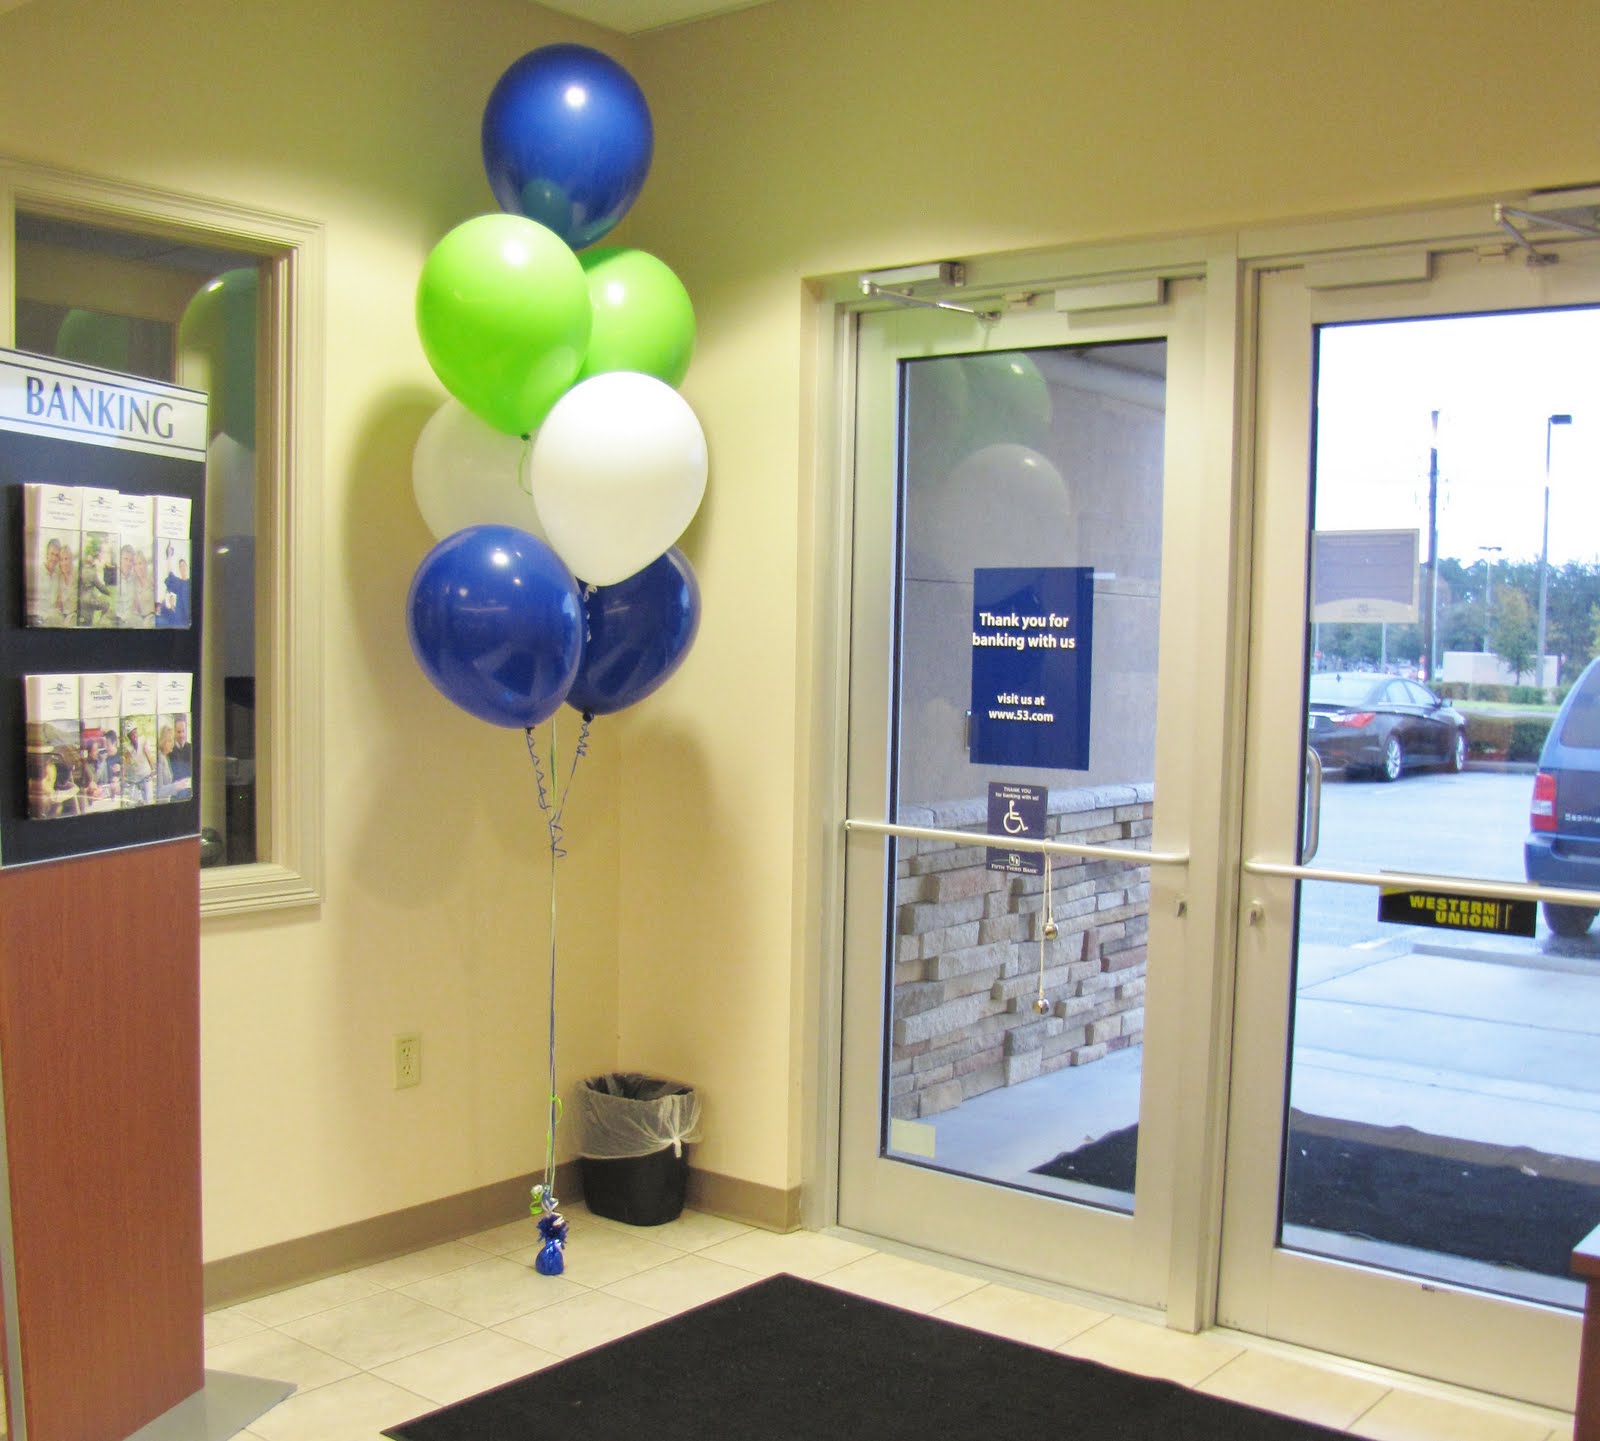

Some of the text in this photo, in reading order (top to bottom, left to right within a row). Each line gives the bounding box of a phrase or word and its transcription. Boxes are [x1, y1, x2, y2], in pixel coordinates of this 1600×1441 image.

[26, 375, 174, 439] BANKING
[979, 612, 1069, 630] Thank you for
[972, 632, 1075, 650] banking with us
[997, 693, 1045, 706] visit us at
[988, 710, 1054, 722] www.53.com
[1409, 895, 1496, 916] WESTERN
[1435, 910, 1496, 929] UNION
